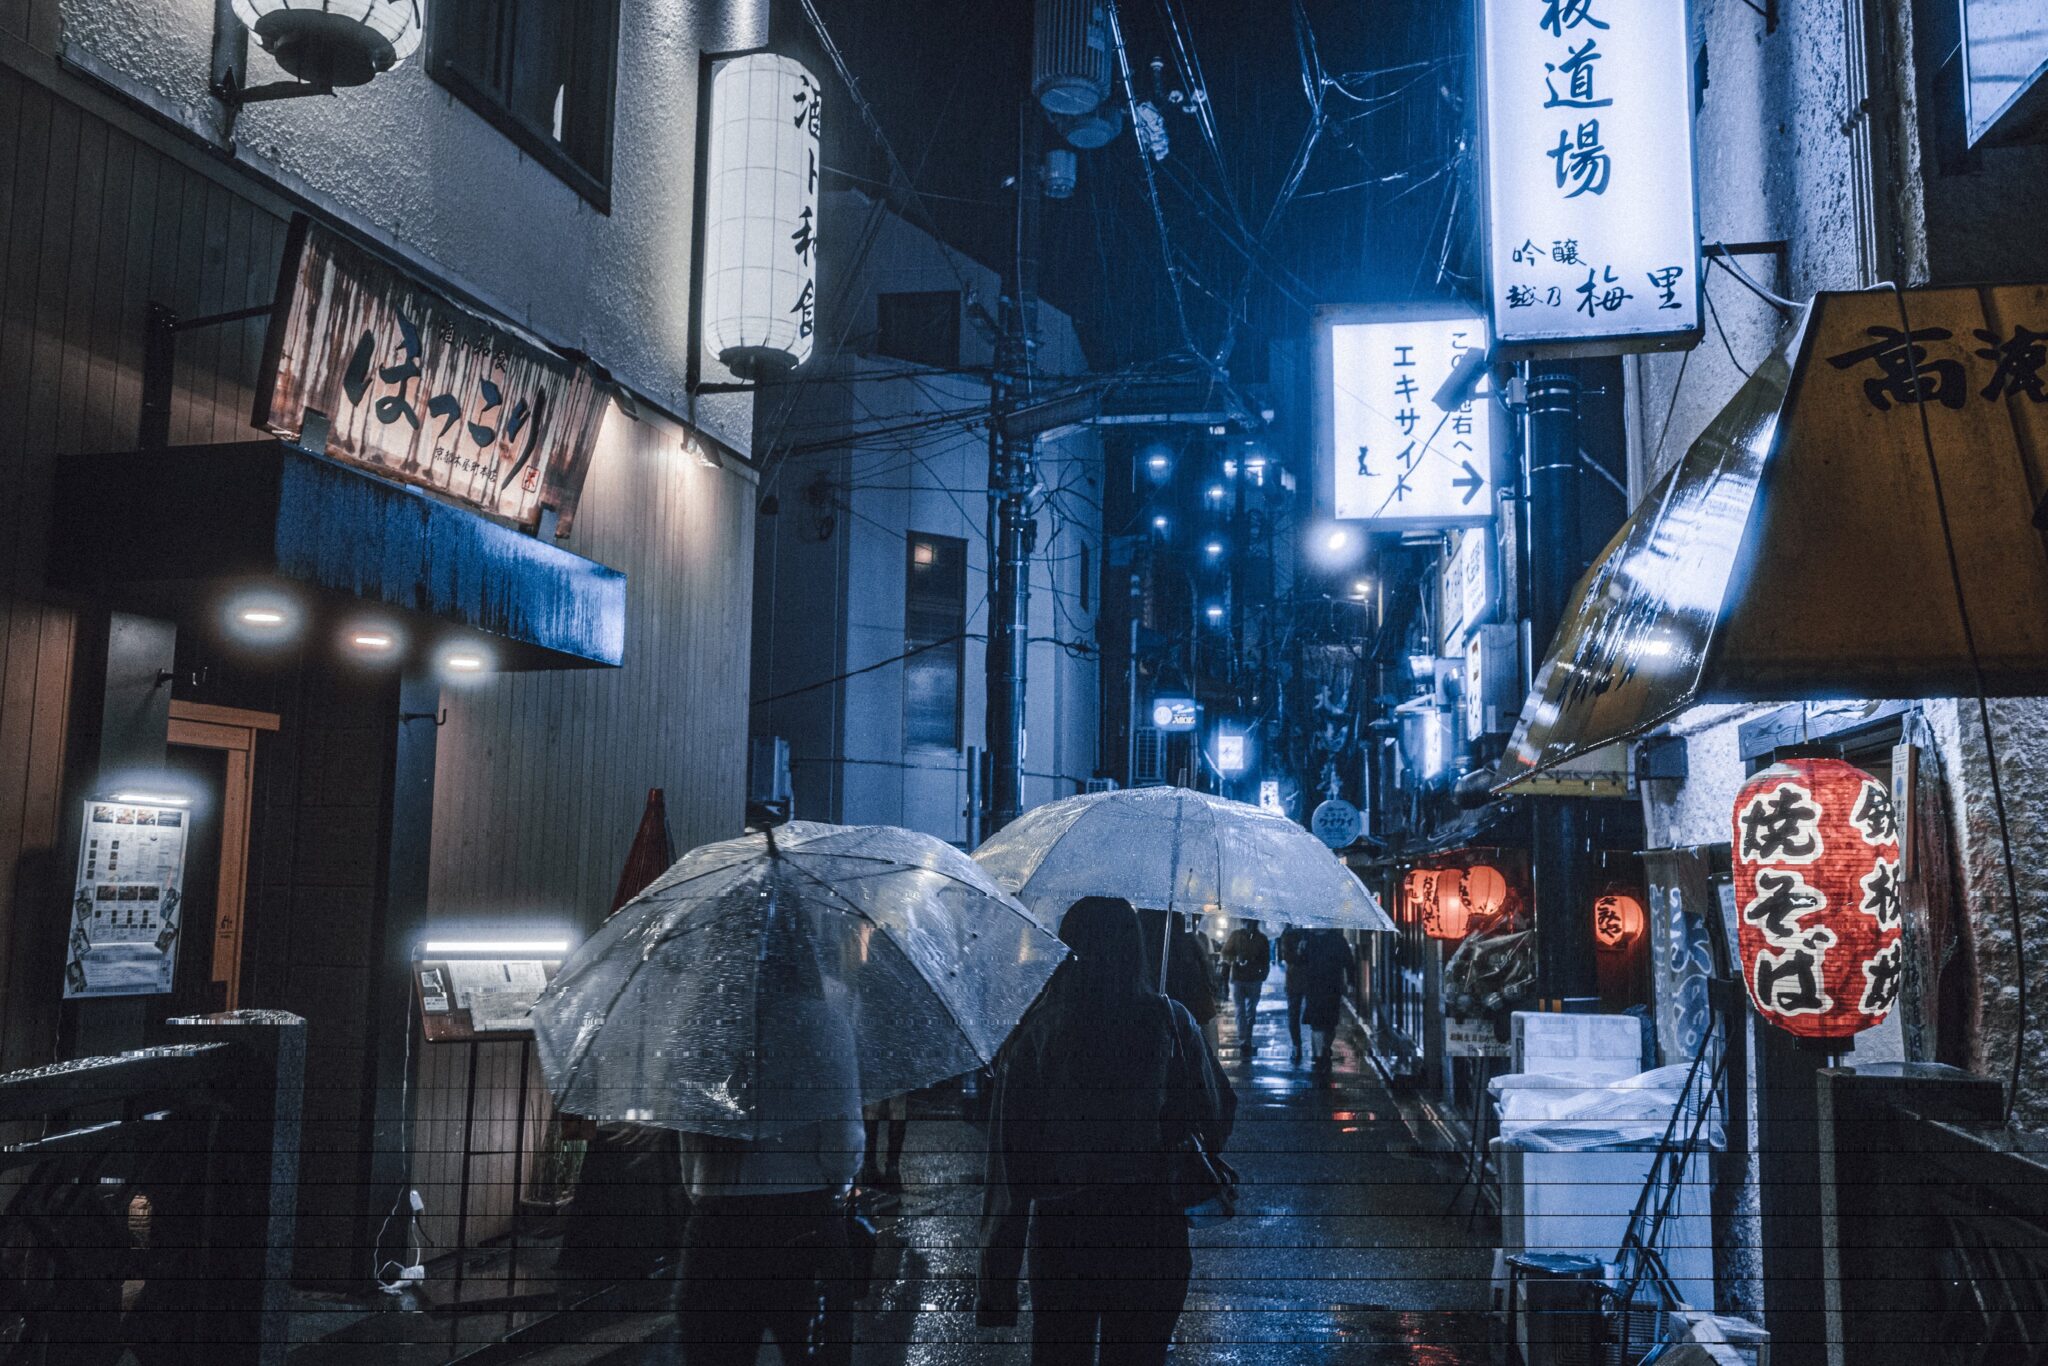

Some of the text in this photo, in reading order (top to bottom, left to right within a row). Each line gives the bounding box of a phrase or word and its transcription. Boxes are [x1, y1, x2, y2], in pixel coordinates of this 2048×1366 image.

[1393, 345, 1421, 502] エキサイト
[1450, 332, 1474, 452] こ右へ
[1740, 785, 1833, 1013] 焼そば
